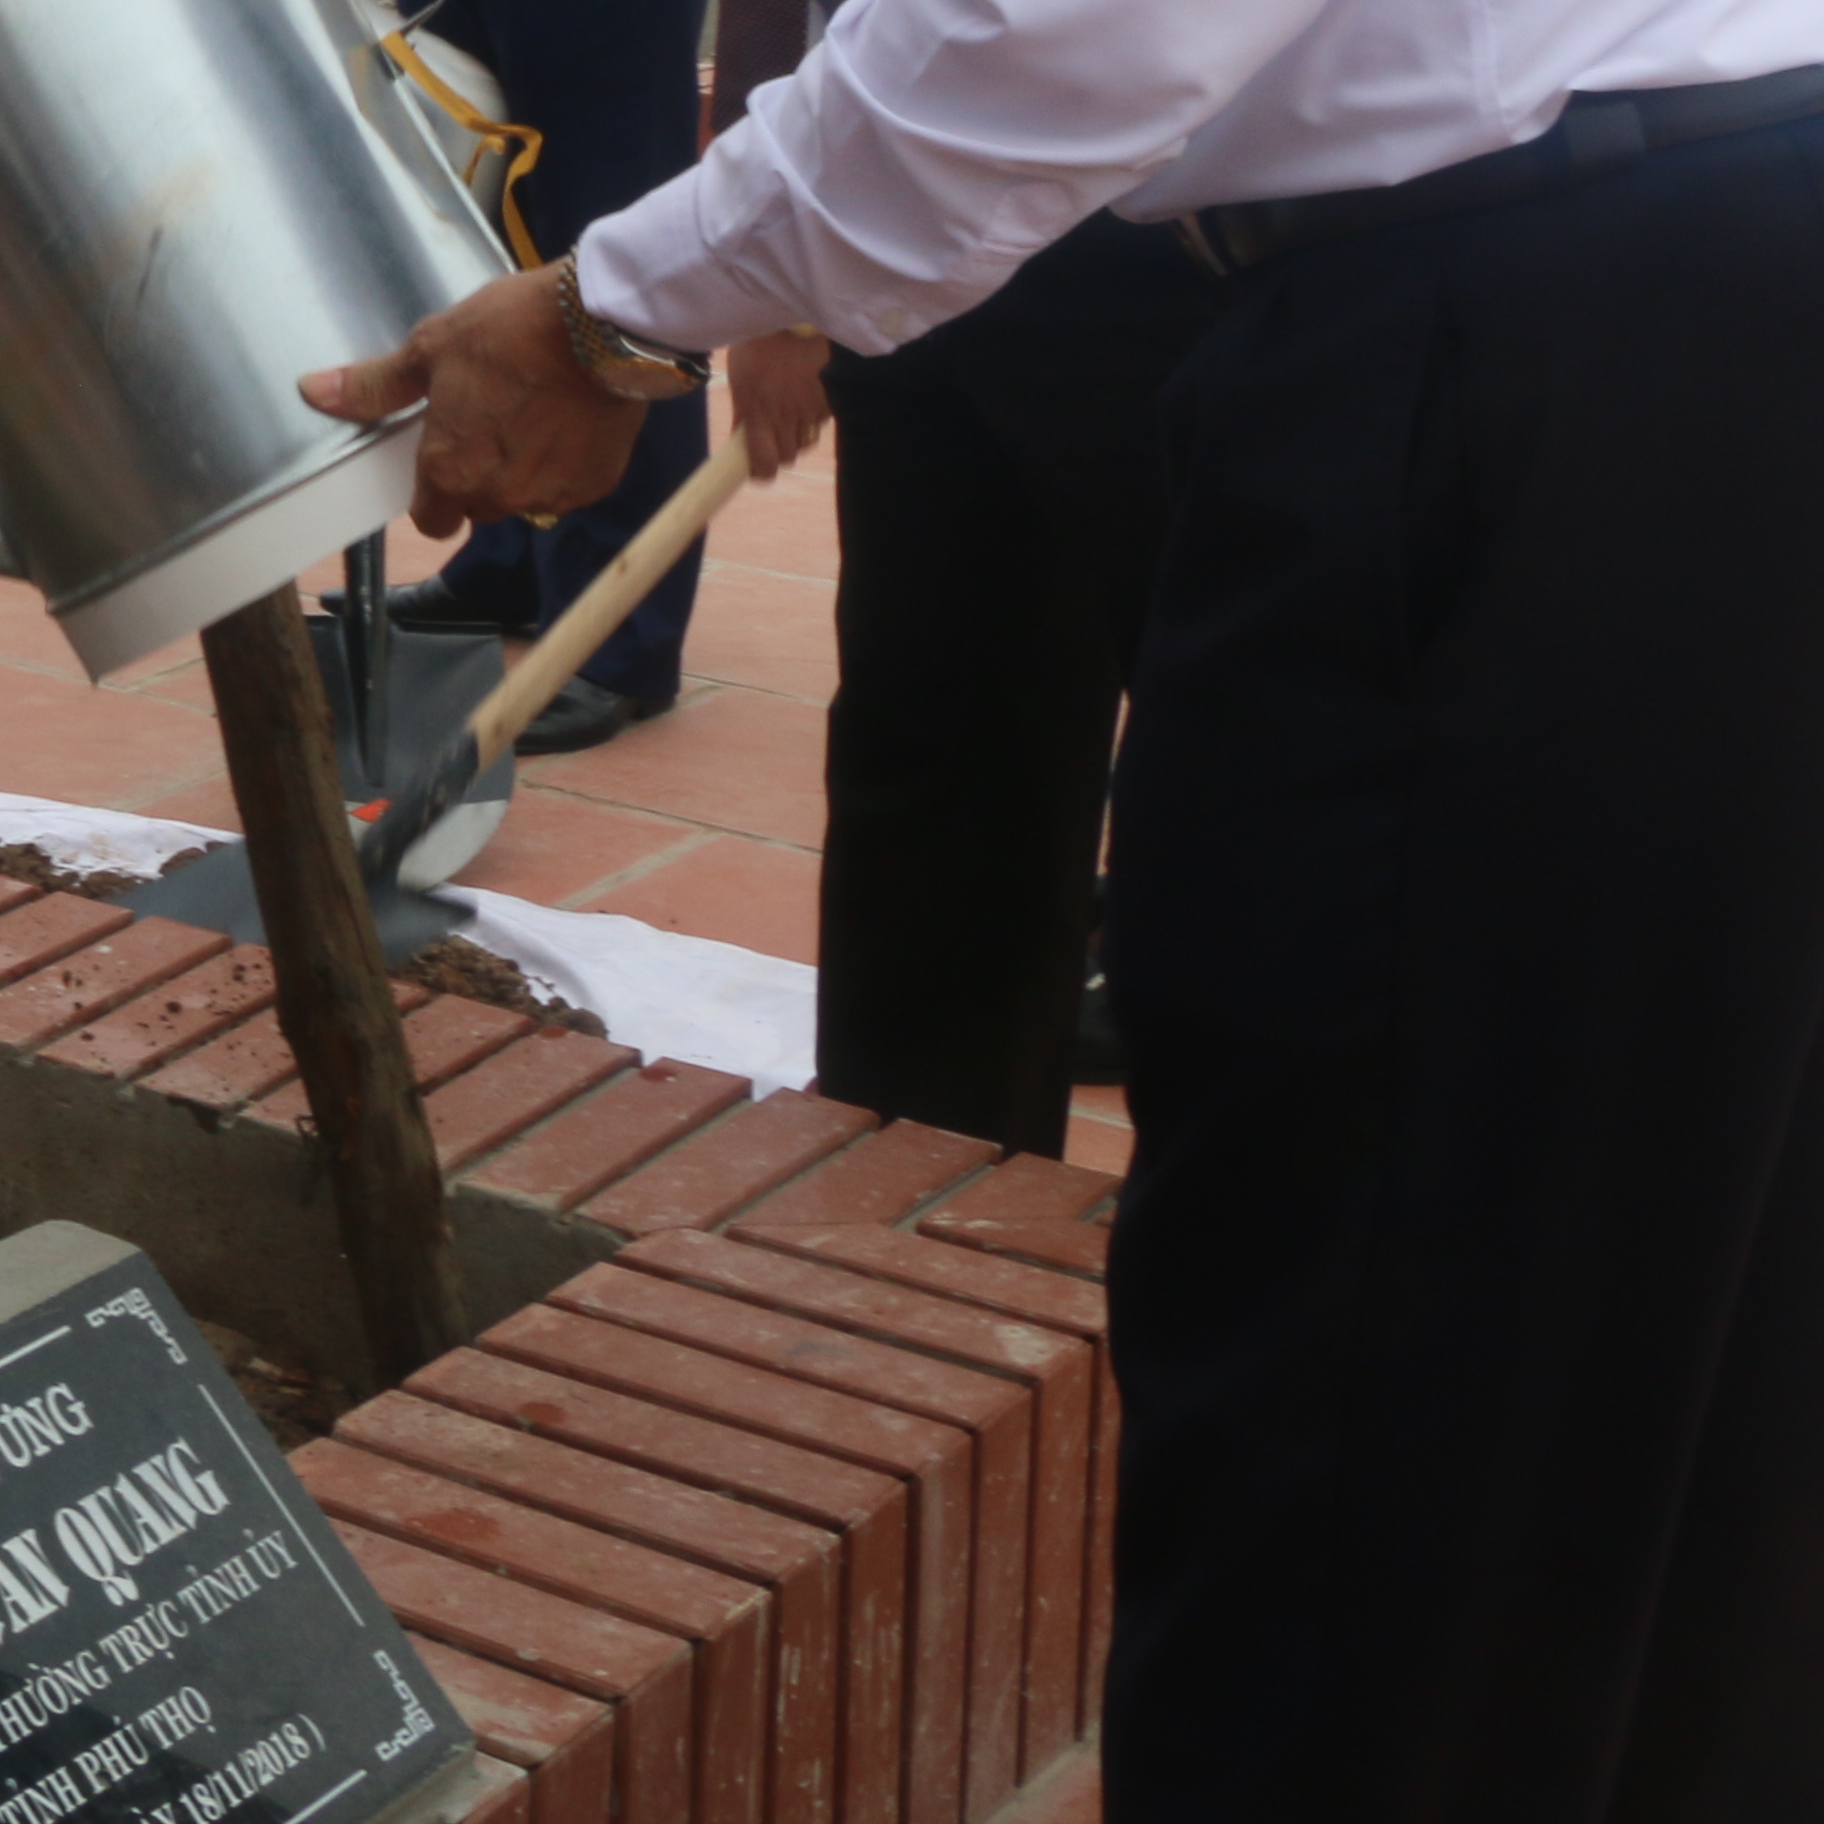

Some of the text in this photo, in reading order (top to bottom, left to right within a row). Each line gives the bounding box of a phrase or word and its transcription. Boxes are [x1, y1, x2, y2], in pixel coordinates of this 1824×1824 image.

[54, 1437, 231, 1607] QUANG
[98, 1599, 189, 1674] TRỰC
[175, 1555, 262, 1624] TỈNH
[73, 1715, 150, 1794] PHÚ
[138, 1685, 217, 1750] THỌ
